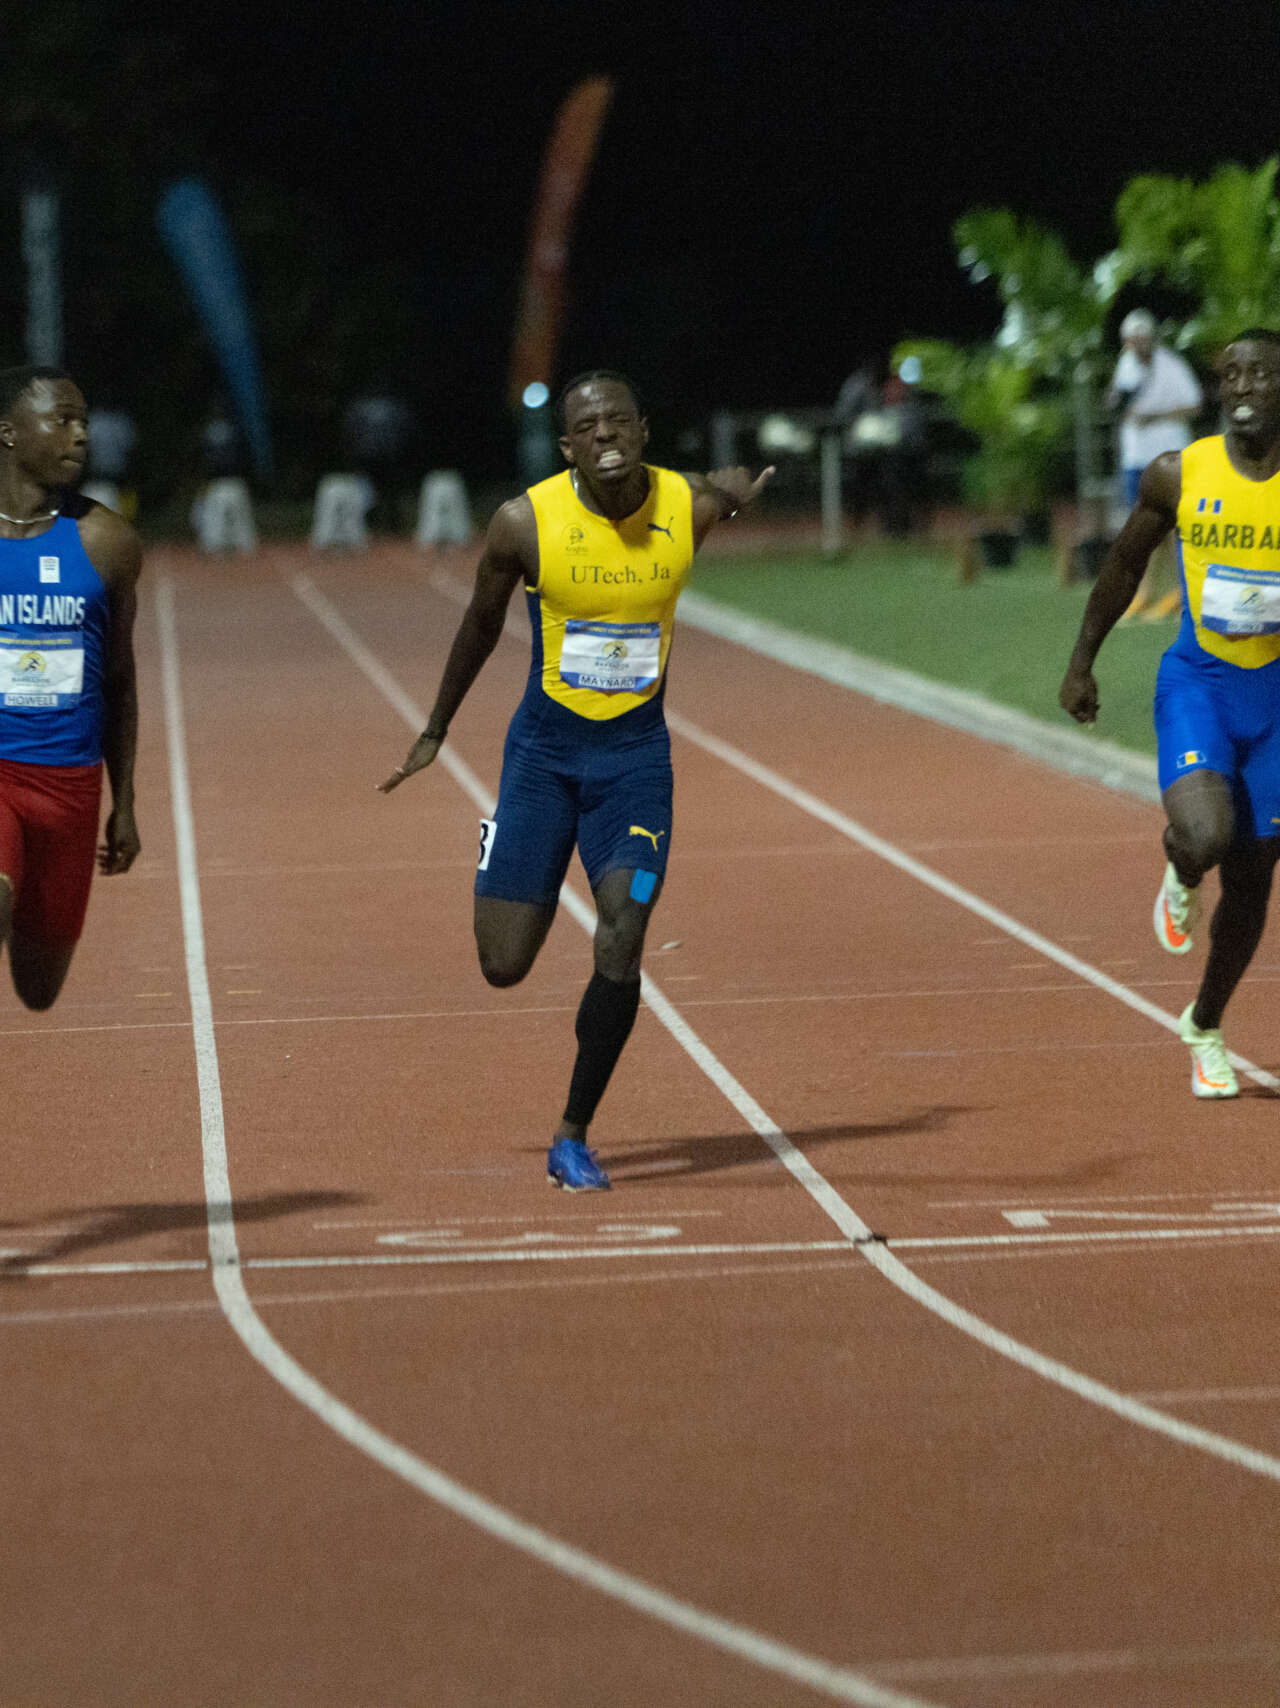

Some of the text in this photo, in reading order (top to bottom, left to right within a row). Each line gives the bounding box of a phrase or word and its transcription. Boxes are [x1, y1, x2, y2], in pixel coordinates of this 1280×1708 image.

[1191, 523, 1280, 550] BARBA
[650, 562, 671, 581] Ja
[18, 594, 86, 626] ISLANDS
[579, 674, 635, 689] MAYNARD
[7, 694, 56, 706] HOWELL
